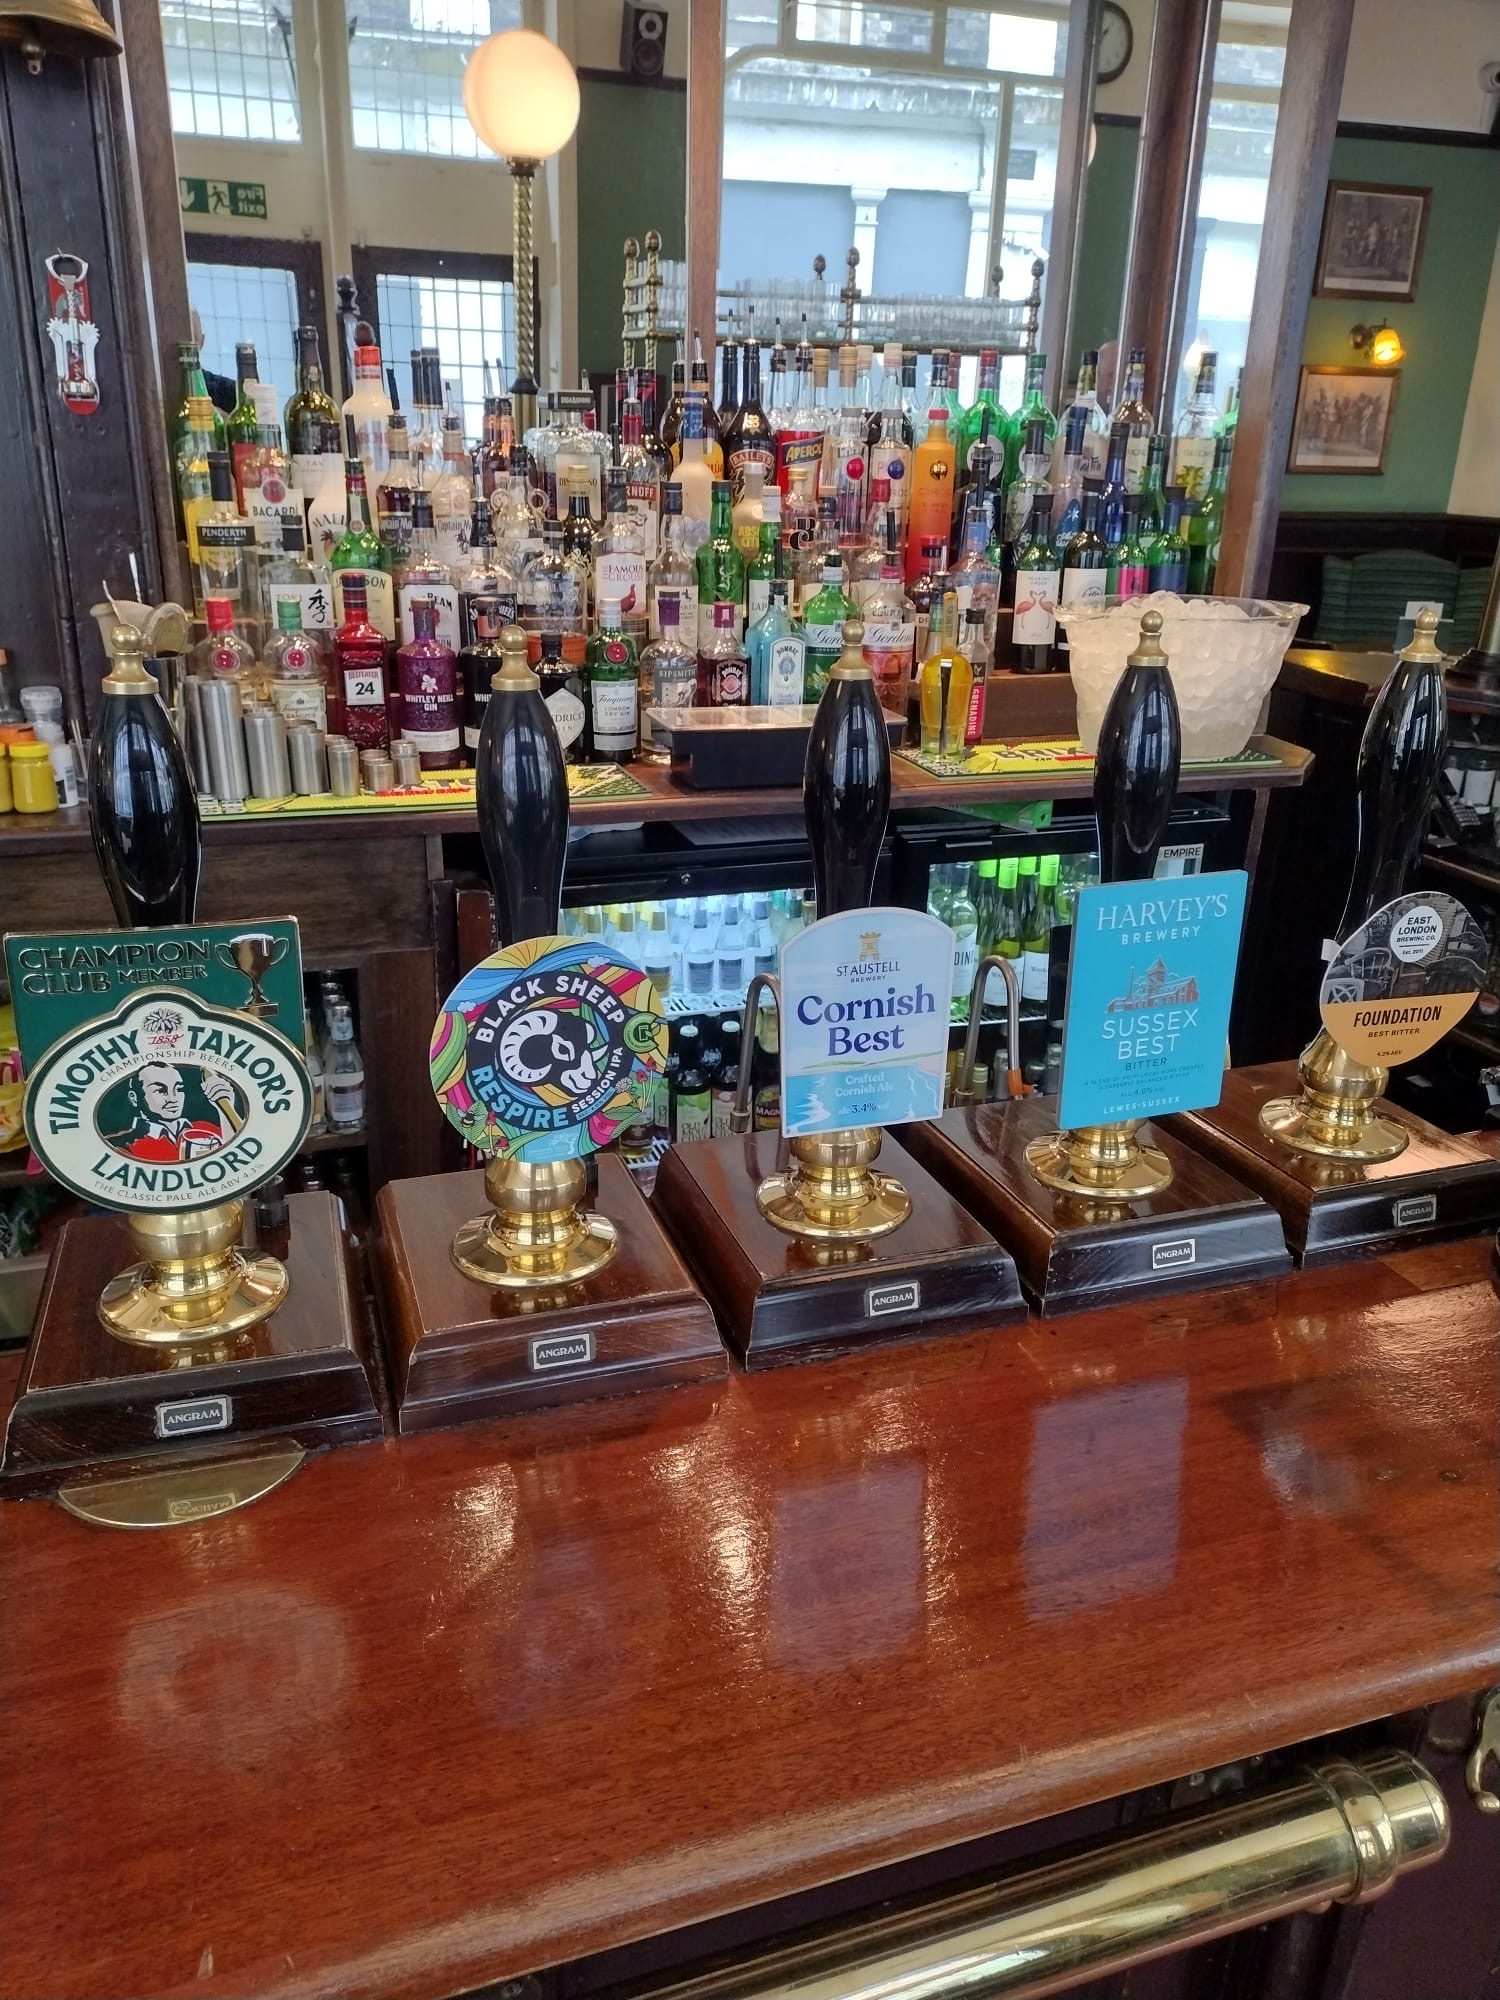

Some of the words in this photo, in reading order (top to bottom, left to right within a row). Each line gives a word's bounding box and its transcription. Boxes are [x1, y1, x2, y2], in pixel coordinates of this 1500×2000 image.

[733, 450, 772, 465] BAILEYS
[202, 527, 247, 537] PENDERYN
[608, 564, 644, 573] FAMOUS
[776, 645, 799, 657] BOMBAY
[659, 669, 697, 679] SIPSMITH
[355, 681, 376, 696] 24
[404, 693, 435, 705] WHITLEY
[437, 693, 455, 703] NEILL
[423, 703, 438, 712] GIN
[967, 688, 980, 736] GRENADINE
[1164, 846, 1202, 858] EMPIRE
[1097, 893, 1229, 931] HARVEY'S
[1407, 916, 1432, 925] EAST
[1121, 926, 1202, 945] BREWERY
[1398, 925, 1437, 935] LONDON
[19, 938, 211, 971] CHAMPION
[850, 961, 901, 976] AUSTELL
[22, 971, 111, 995] CLUB
[118, 965, 208, 985] MEMBER
[850, 975, 886, 983] BREWERY
[475, 977, 545, 1044] BLACK
[554, 974, 625, 1025] SHEEP
[797, 983, 936, 1026] Cornish
[1102, 1008, 1200, 1040] SUSSEX
[1353, 1005, 1442, 1028] FOUNDATION
[149, 1033, 184, 1046] 1858
[827, 1024, 905, 1057] Best
[1368, 1030, 1389, 1038] BEST
[1391, 1028, 1421, 1036] BITTER
[1118, 1032, 1181, 1060] BEST
[100, 1050, 196, 1083] CHAMPIONSHIP
[200, 1053, 236, 1072] BEERS
[1125, 1057, 1168, 1071] BITTER
[49, 1028, 139, 1135] TIMOTHY
[187, 1025, 291, 1115] TAYLOR'S
[571, 1069, 617, 1113] SESSION
[610, 1047, 623, 1068] IPA
[845, 1071, 885, 1086] Crafted
[471, 1064, 570, 1129] RESPIRE
[835, 1083, 876, 1097] Cornish
[877, 1081, 894, 1092] Ale
[755, 1105, 780, 1117] MAGN
[851, 1102, 877, 1114] 3.4%
[90, 1136, 263, 1192] LANDLORD
[94, 1181, 114, 1194] THE
[117, 1189, 163, 1202] CLASSIC
[166, 1193, 193, 1202] PALE
[198, 1187, 218, 1198] ALE
[220, 1176, 240, 1191] ABV
[1400, 1206, 1433, 1218] ANGRAM
[1155, 1247, 1191, 1260] ANGRAM
[873, 1292, 913, 1307] ANGRAM
[538, 1344, 585, 1359] ANGRAM
[166, 1409, 221, 1425] ANGRAM
